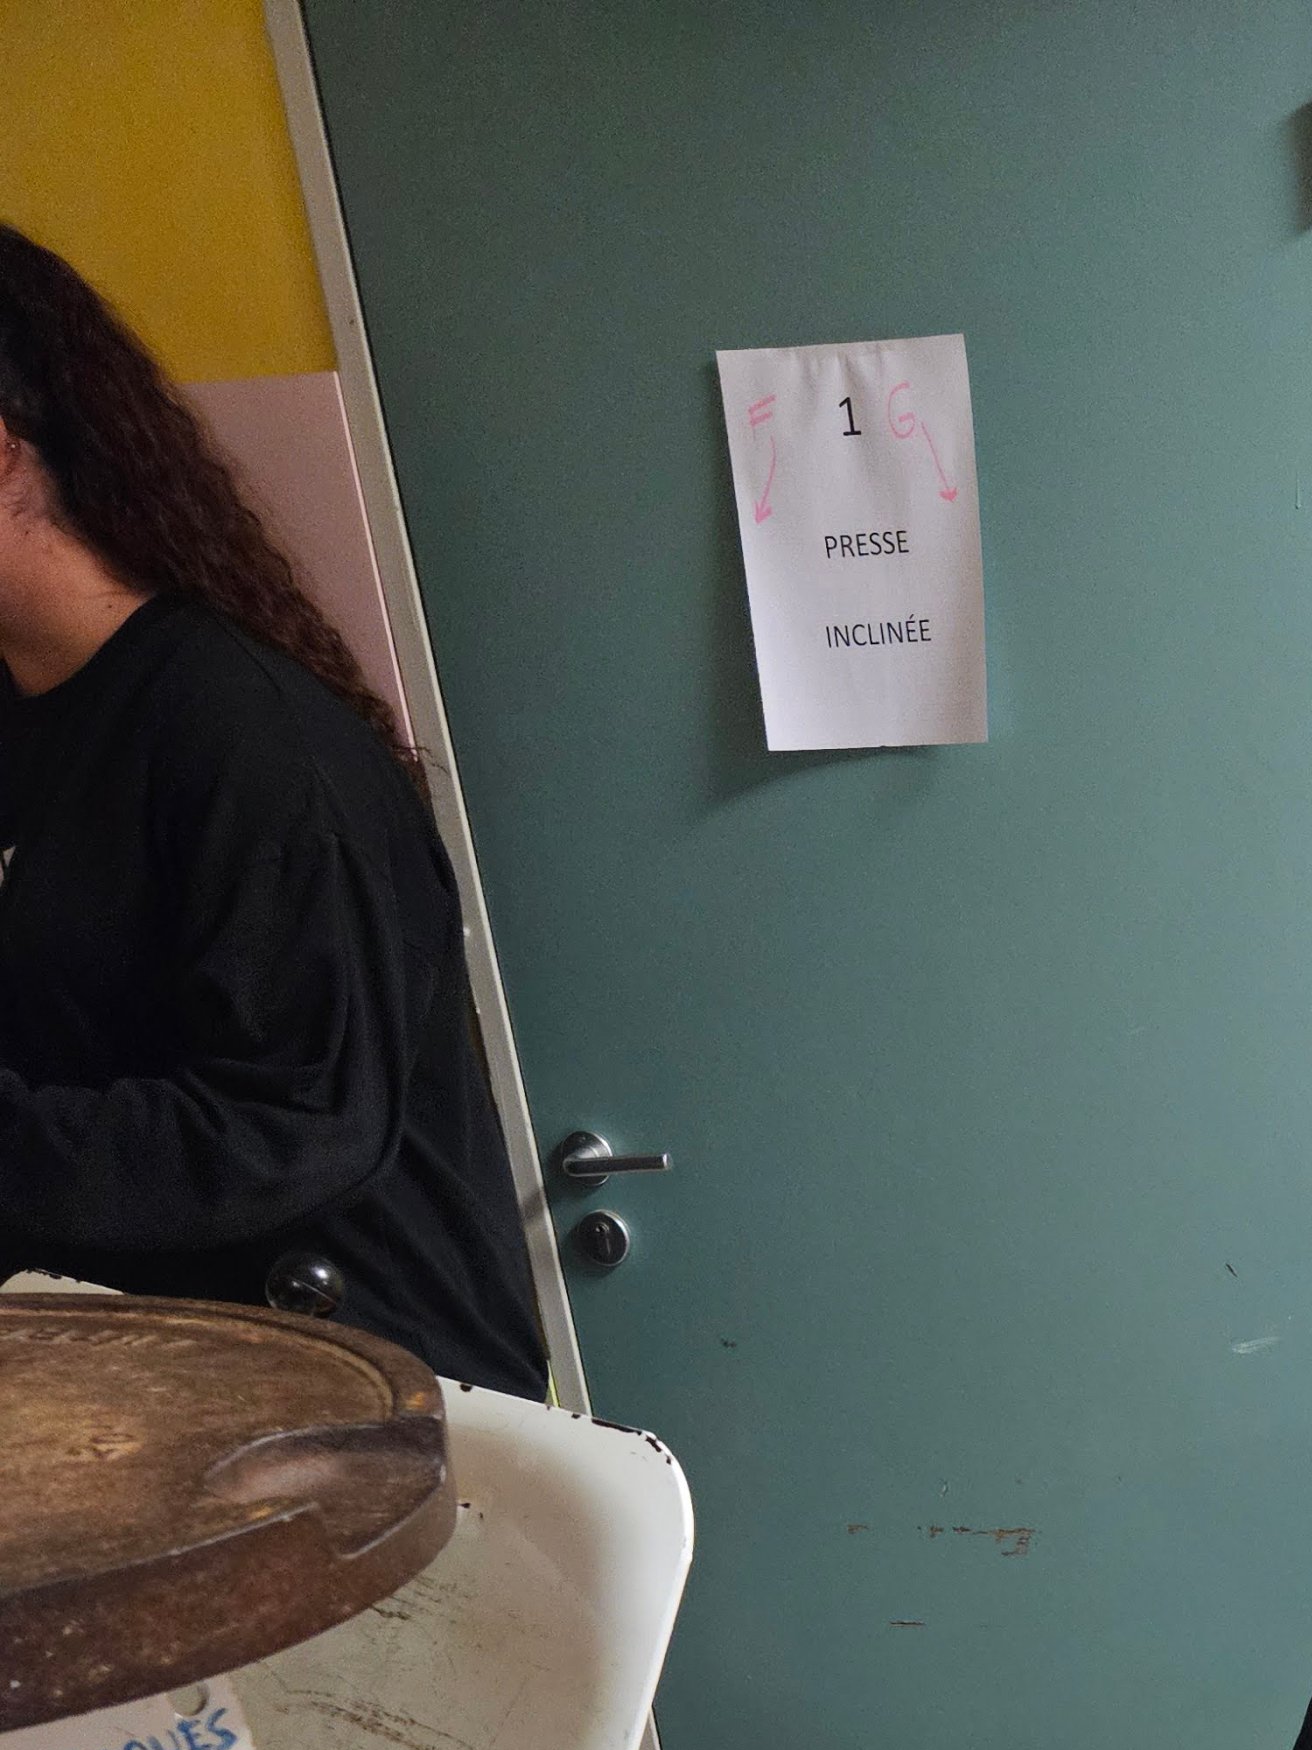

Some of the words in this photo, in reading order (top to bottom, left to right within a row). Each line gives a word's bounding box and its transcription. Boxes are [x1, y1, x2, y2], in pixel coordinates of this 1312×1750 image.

[839, 396, 862, 437] 1
[887, 382, 916, 440] G
[824, 529, 910, 559] PRESSE
[826, 614, 932, 648] INCLINÉE
